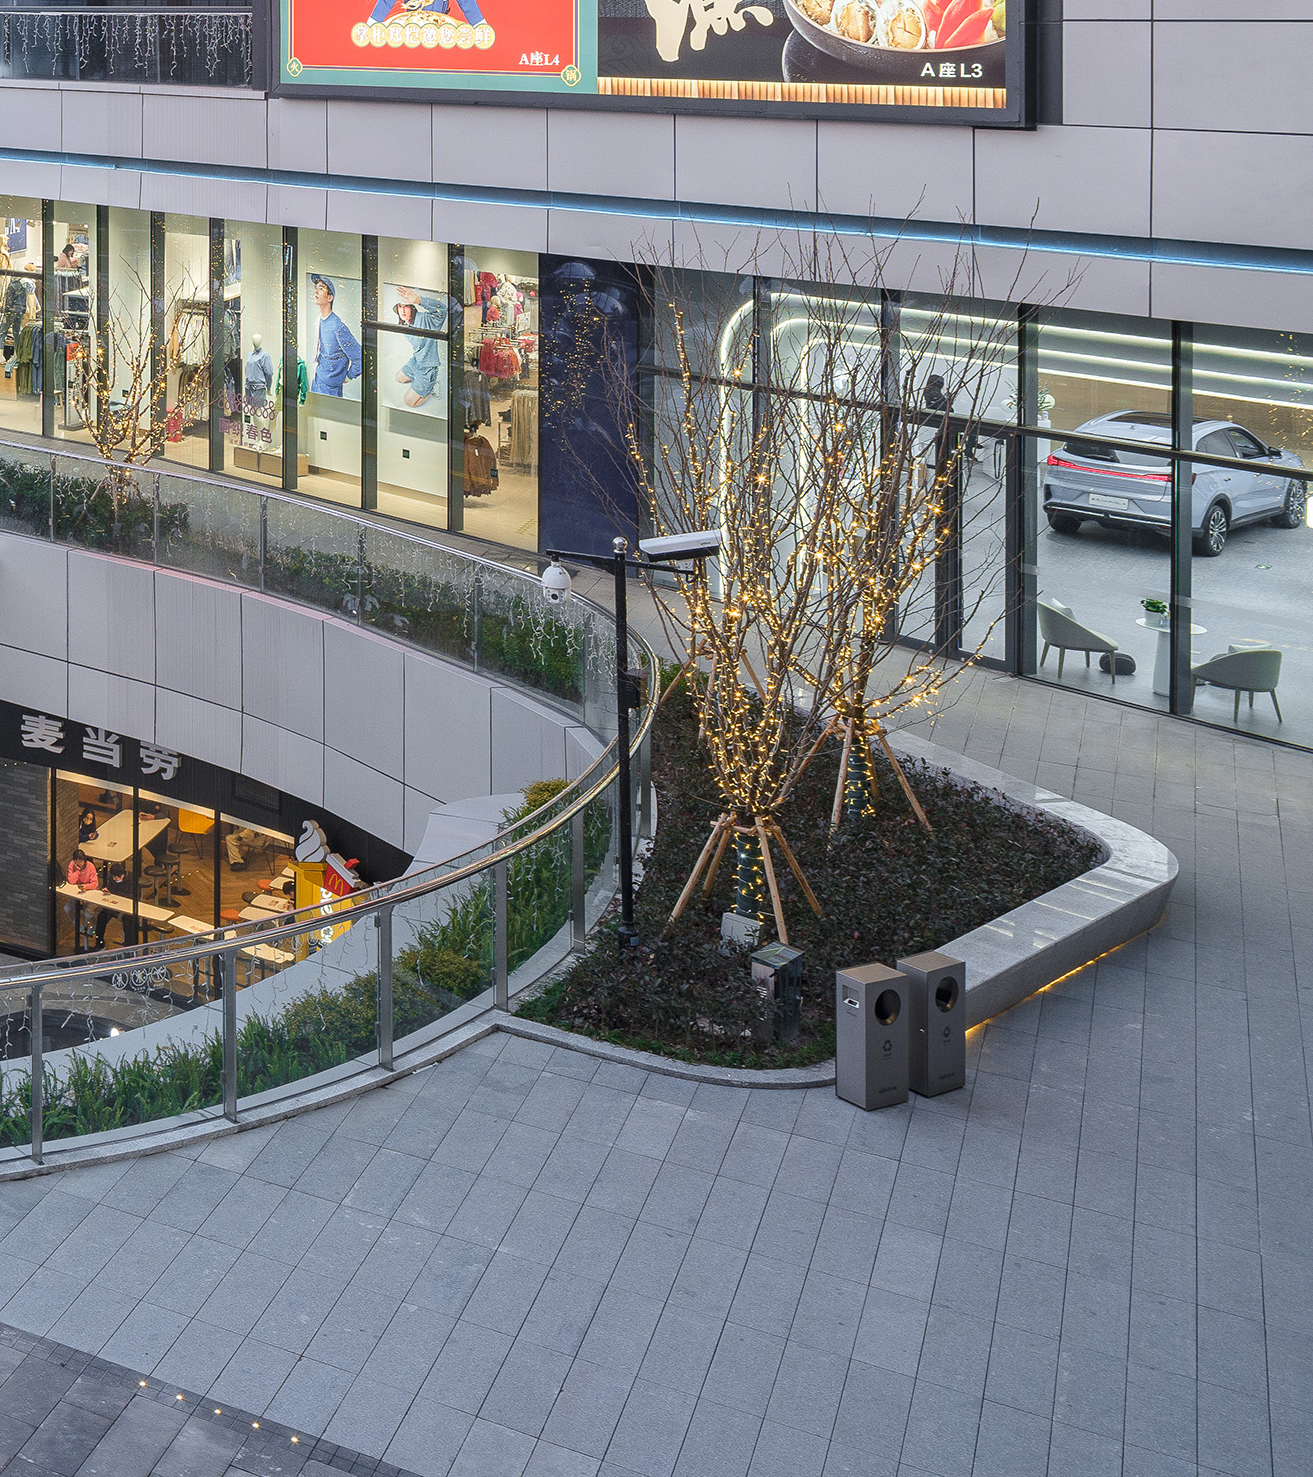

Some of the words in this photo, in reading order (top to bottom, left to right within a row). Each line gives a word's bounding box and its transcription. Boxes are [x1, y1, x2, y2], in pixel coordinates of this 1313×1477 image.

[518, 50, 561, 67] A座L4
[920, 62, 984, 78] A座L3
[20, 714, 183, 781] 麦当劳
